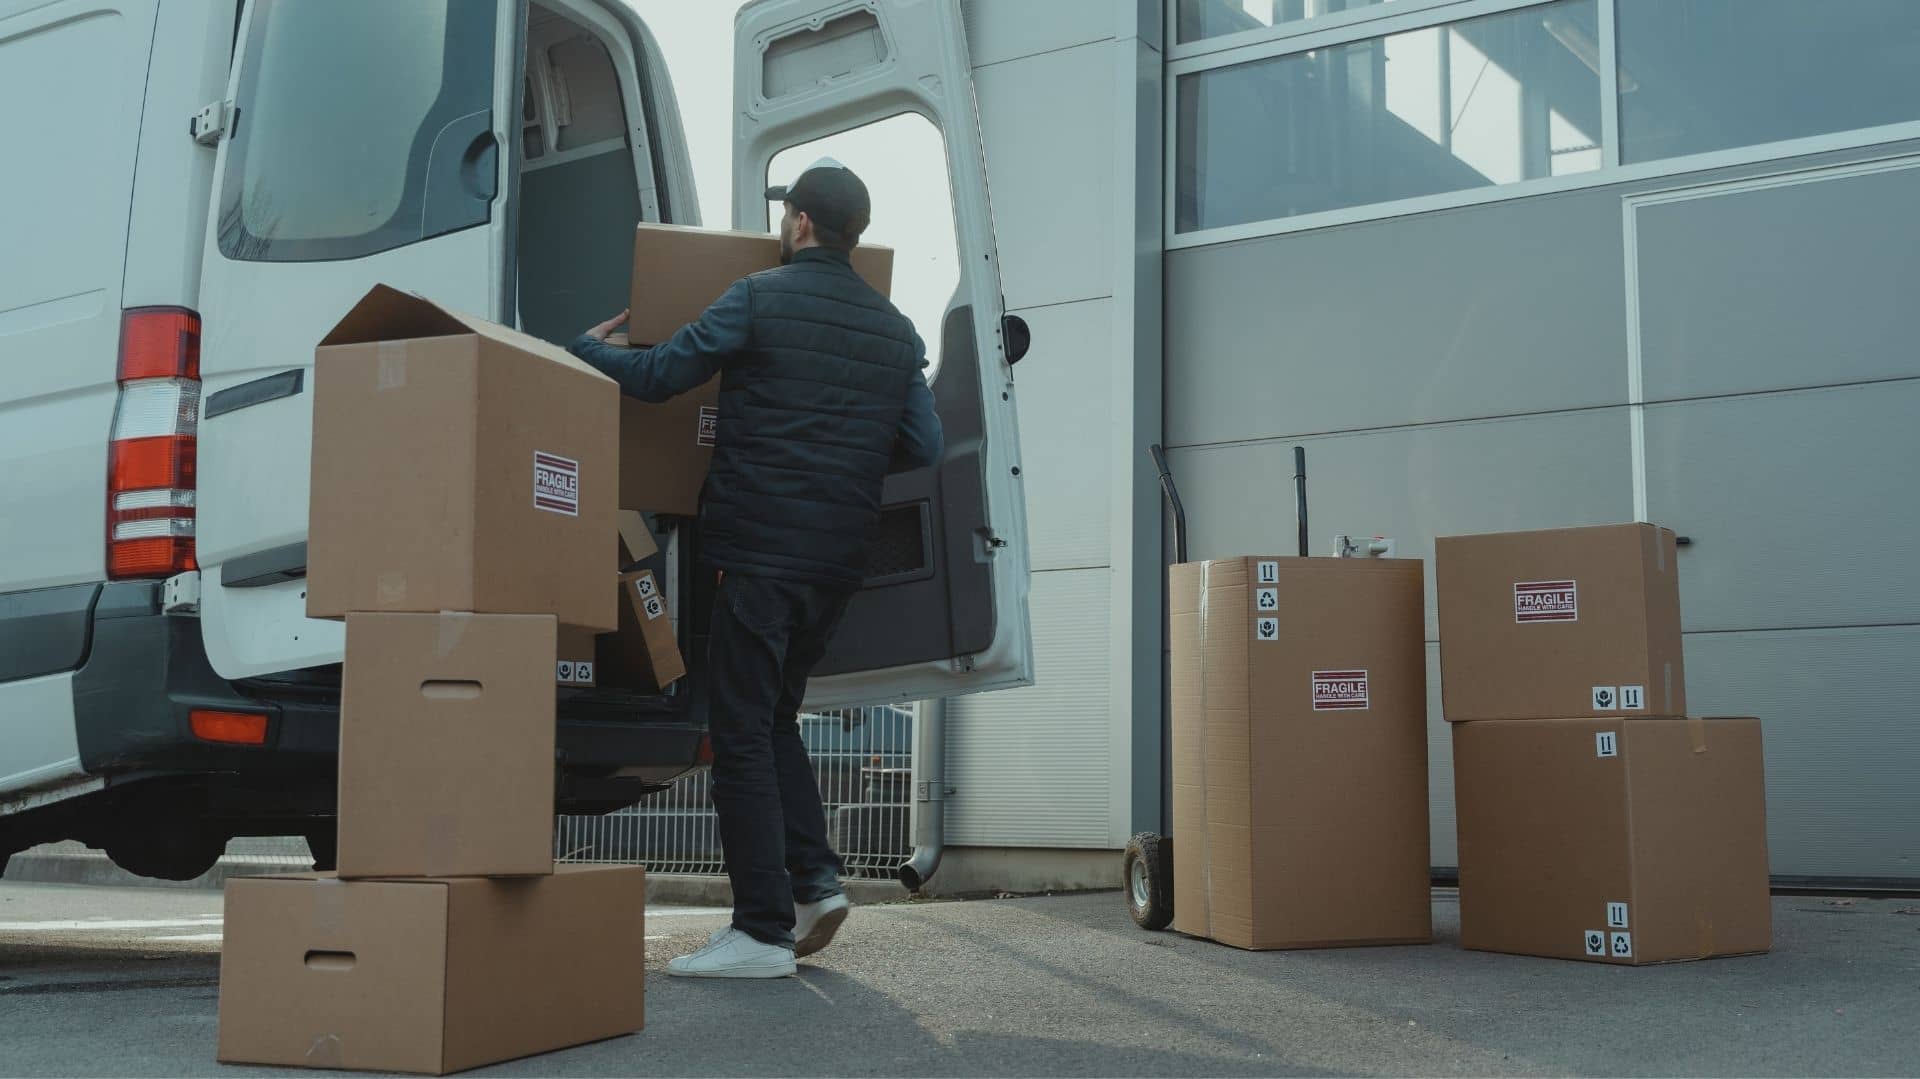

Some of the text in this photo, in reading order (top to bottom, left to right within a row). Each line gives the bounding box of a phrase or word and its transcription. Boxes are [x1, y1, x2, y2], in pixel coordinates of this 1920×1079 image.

[536, 470, 575, 492] FRAGILE
[1517, 593, 1573, 605] FRAGILE
[1315, 682, 1365, 693] FRAGILE
